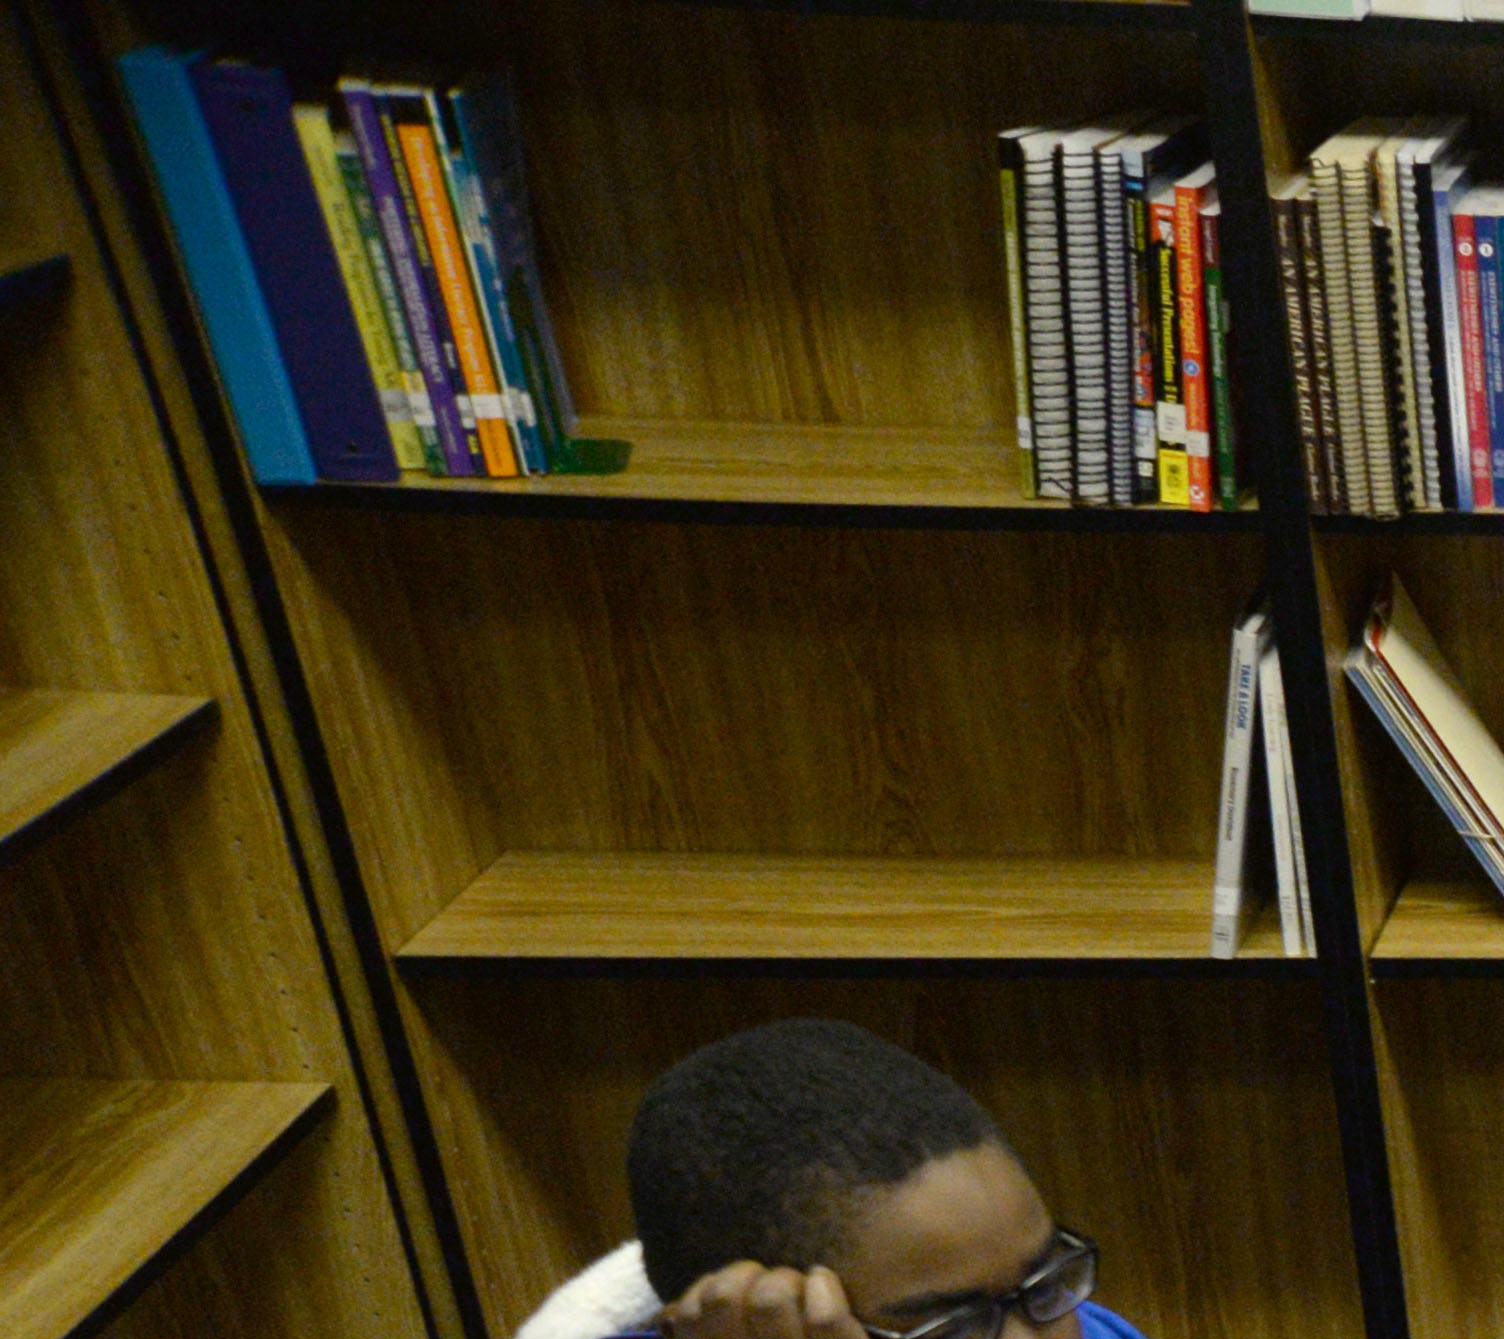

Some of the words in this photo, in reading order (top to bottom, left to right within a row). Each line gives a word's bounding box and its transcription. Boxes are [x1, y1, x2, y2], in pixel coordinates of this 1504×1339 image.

[1174, 194, 1195, 254] instant
[1179, 258, 1195, 292] web
[1280, 256, 1296, 279] AN
[1303, 258, 1318, 277] AN
[1178, 296, 1201, 354] pages!
[1284, 282, 1308, 368] AMERICAN
[1307, 283, 1330, 368] AMERICAN
[1294, 374, 1316, 436] PLAGUE
[1316, 374, 1337, 435] PLAGUE
